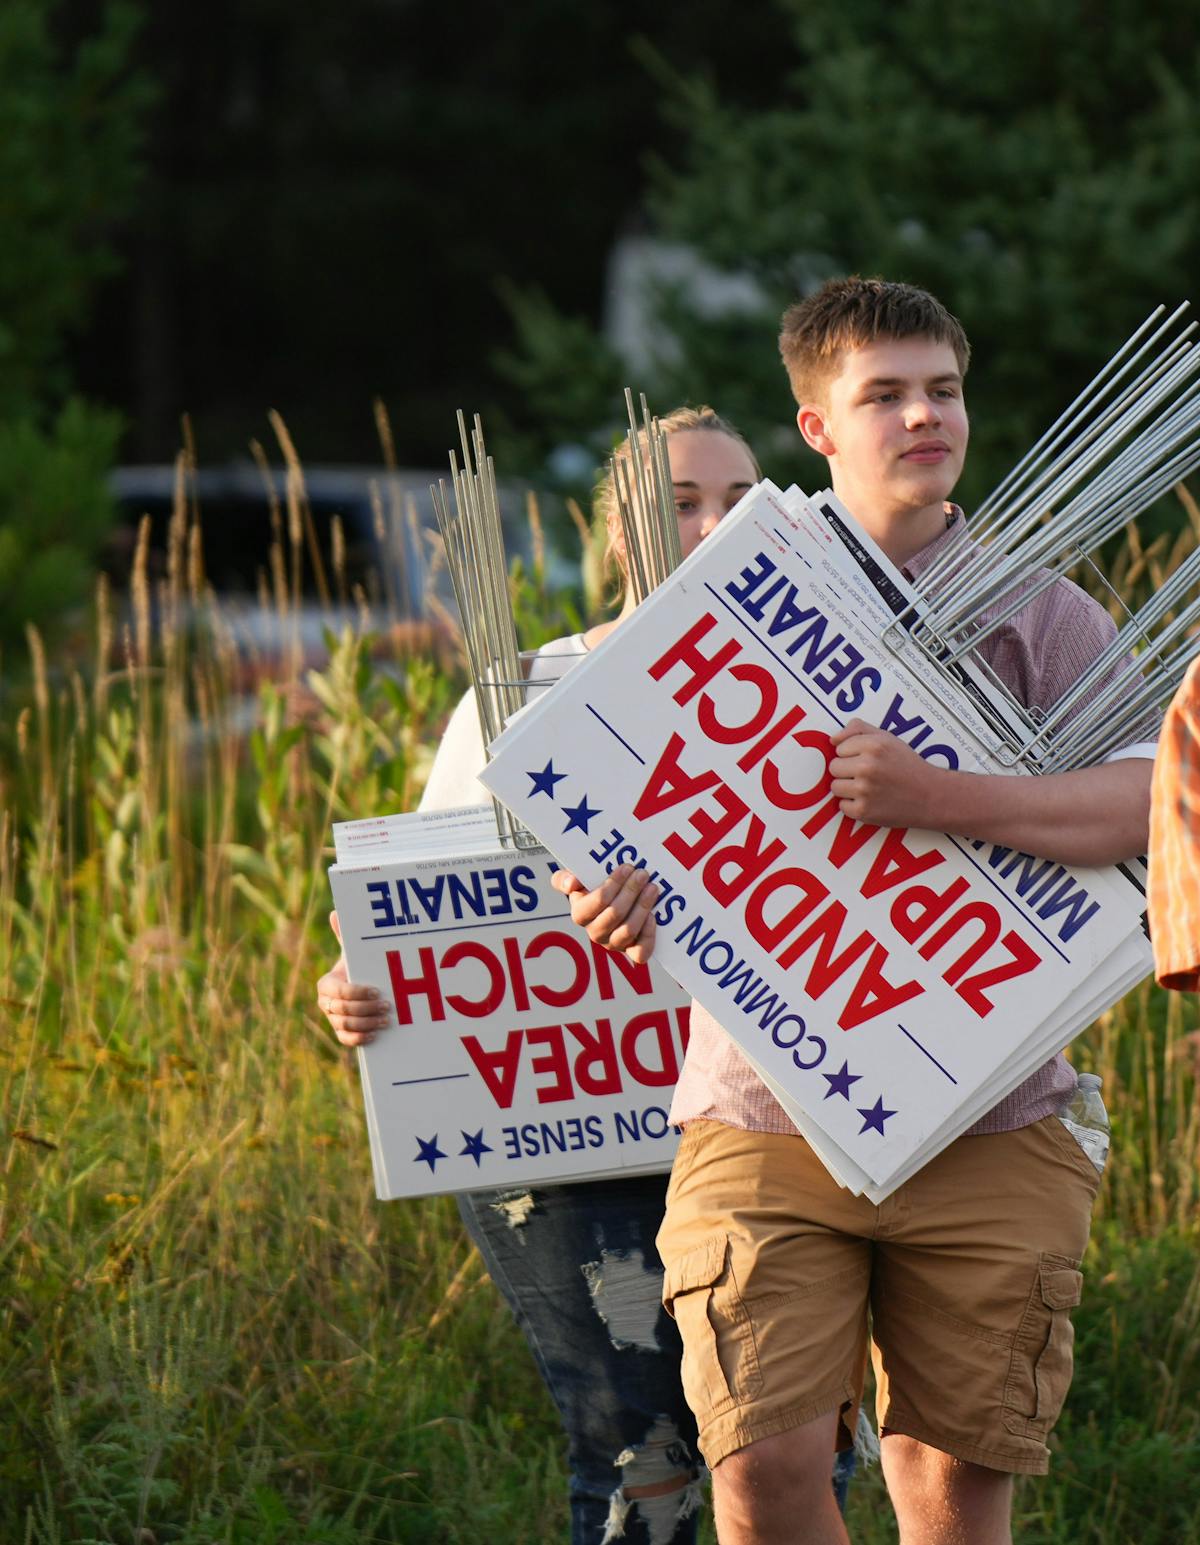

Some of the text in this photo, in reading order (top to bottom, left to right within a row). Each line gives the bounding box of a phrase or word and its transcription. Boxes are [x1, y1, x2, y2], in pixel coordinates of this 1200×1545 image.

[725, 552, 882, 713] SENATE
[806, 580, 827, 602] 55706
[632, 731, 927, 1032] ANDREA
[647, 611, 1043, 1020] ZUPANCICH
[366, 866, 539, 928] SENATE
[674, 916, 827, 1070] COMMON
[502, 1114, 605, 1159] SENSE
